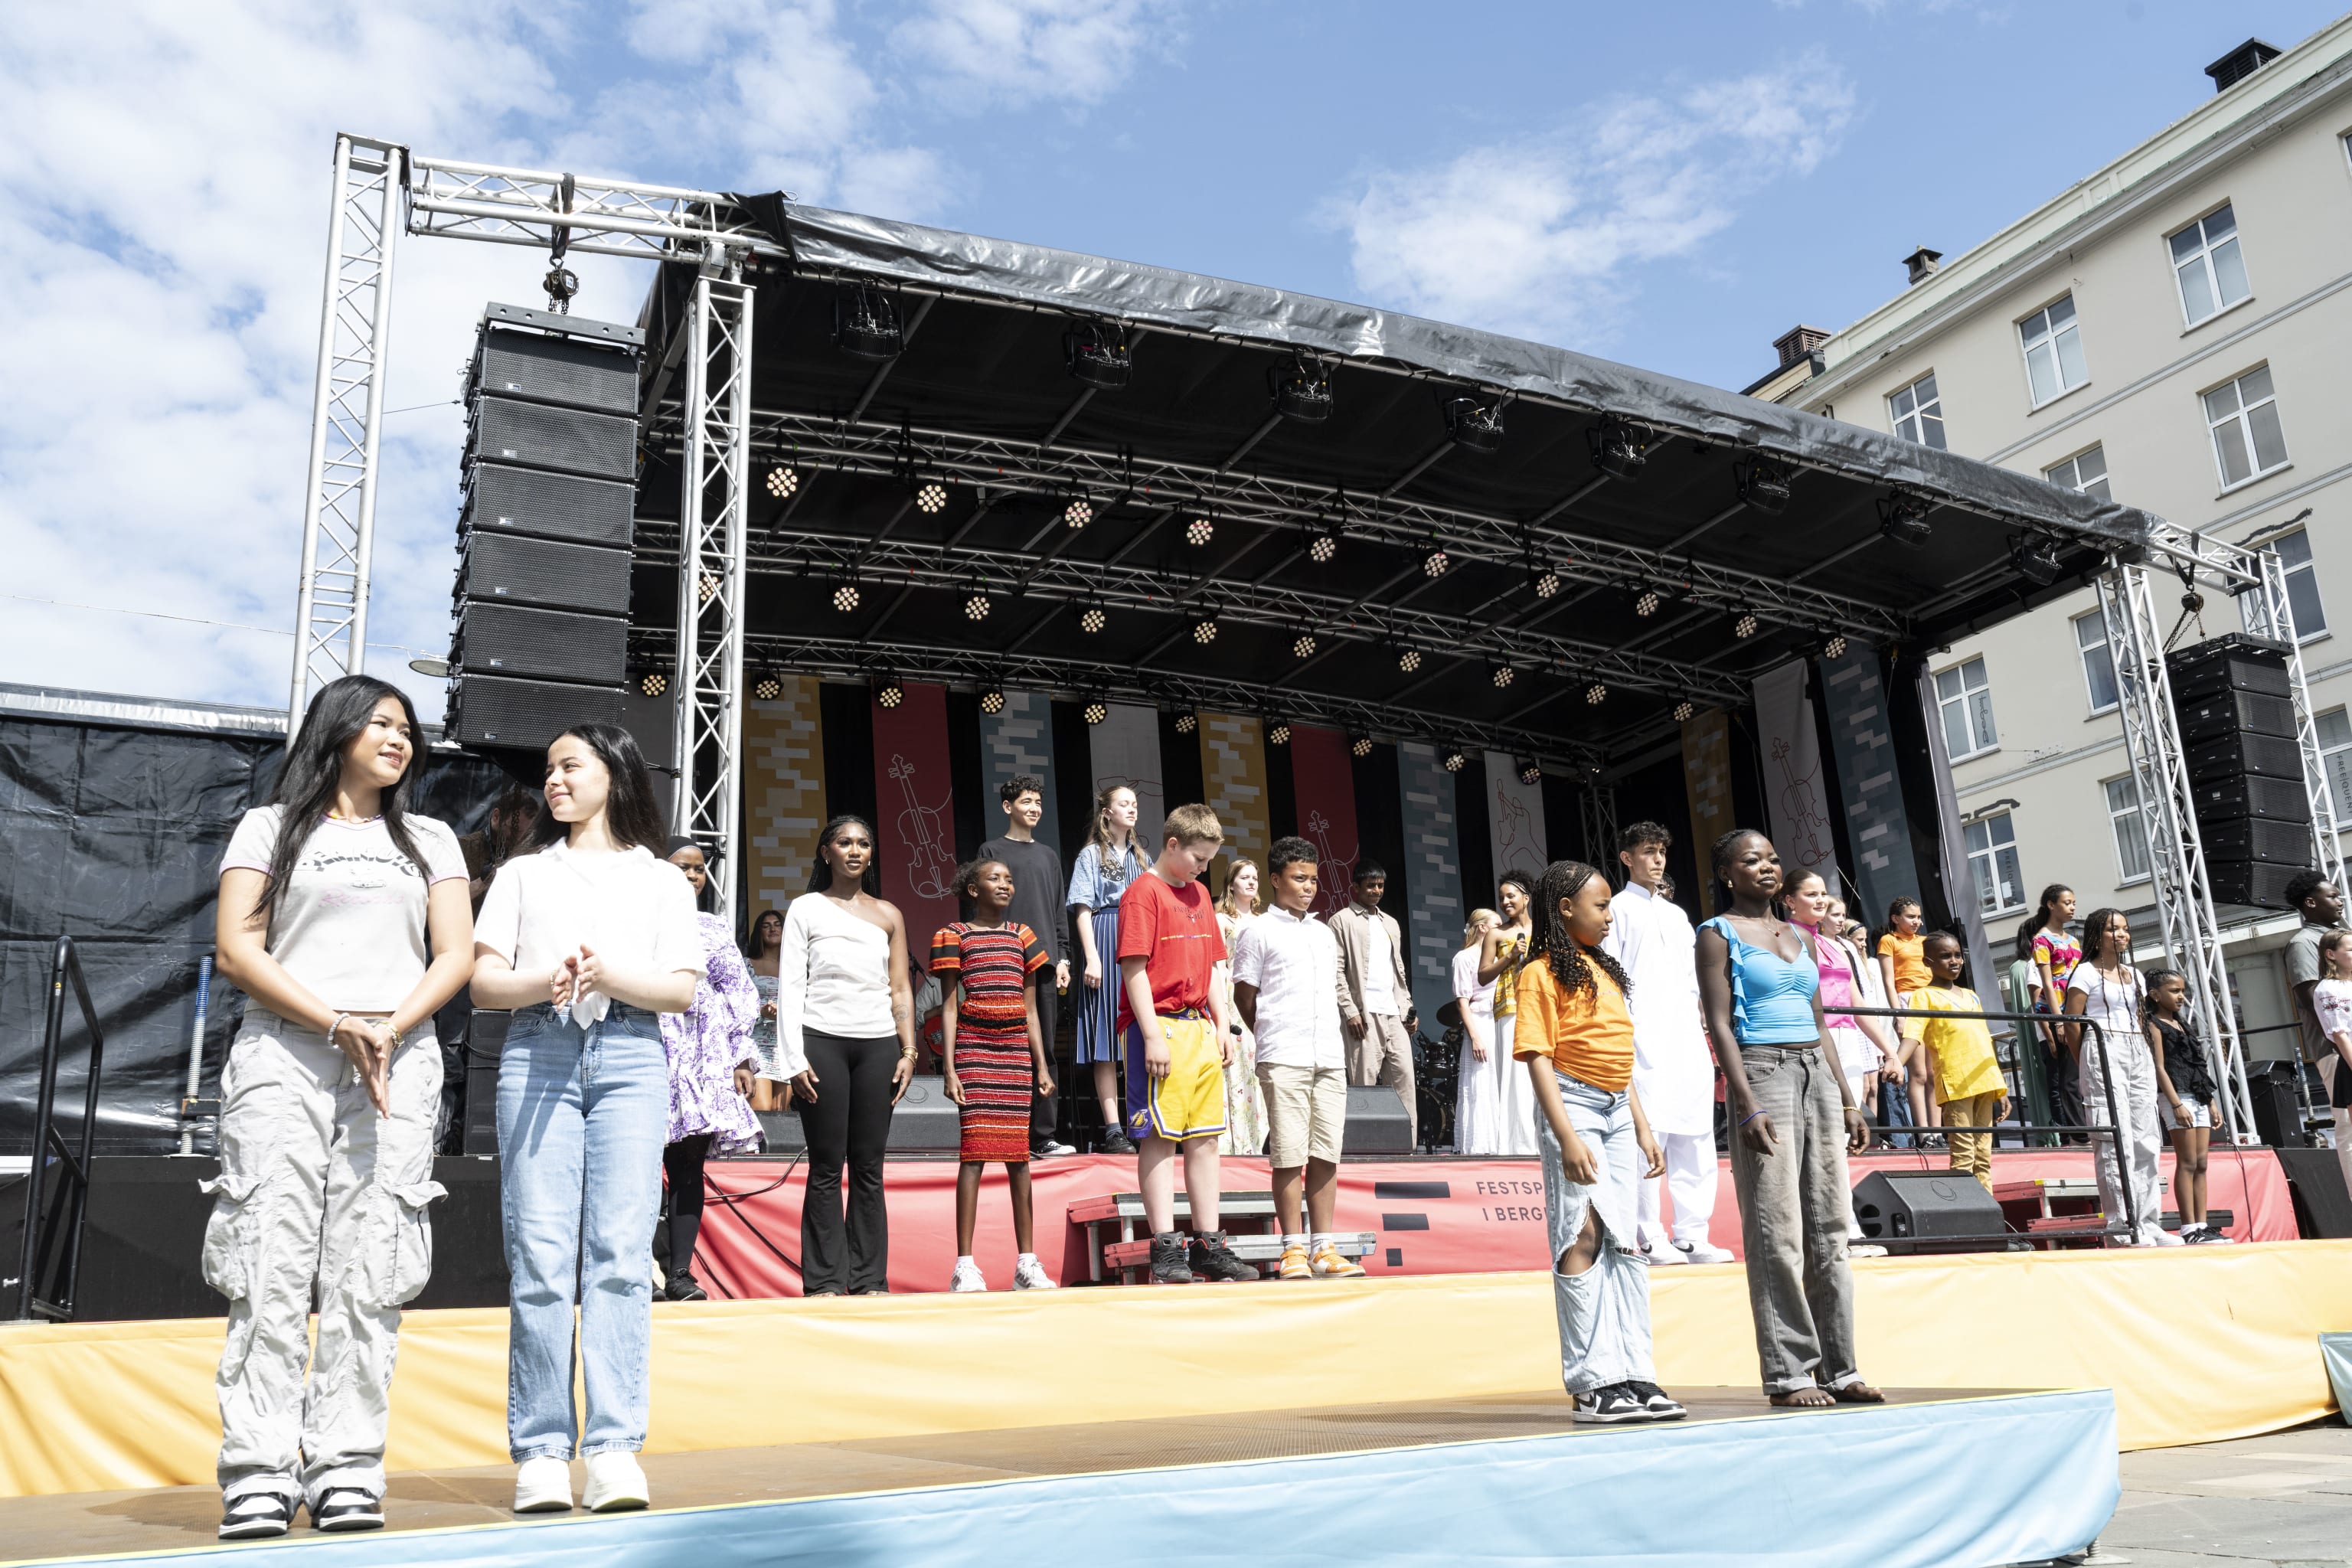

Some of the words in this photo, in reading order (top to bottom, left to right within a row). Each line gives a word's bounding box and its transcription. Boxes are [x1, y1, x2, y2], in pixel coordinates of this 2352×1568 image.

[1475, 1181, 1543, 1194] FESTSP
[1482, 1207, 1488, 1221] I
[1494, 1207, 1547, 1221] BERG
